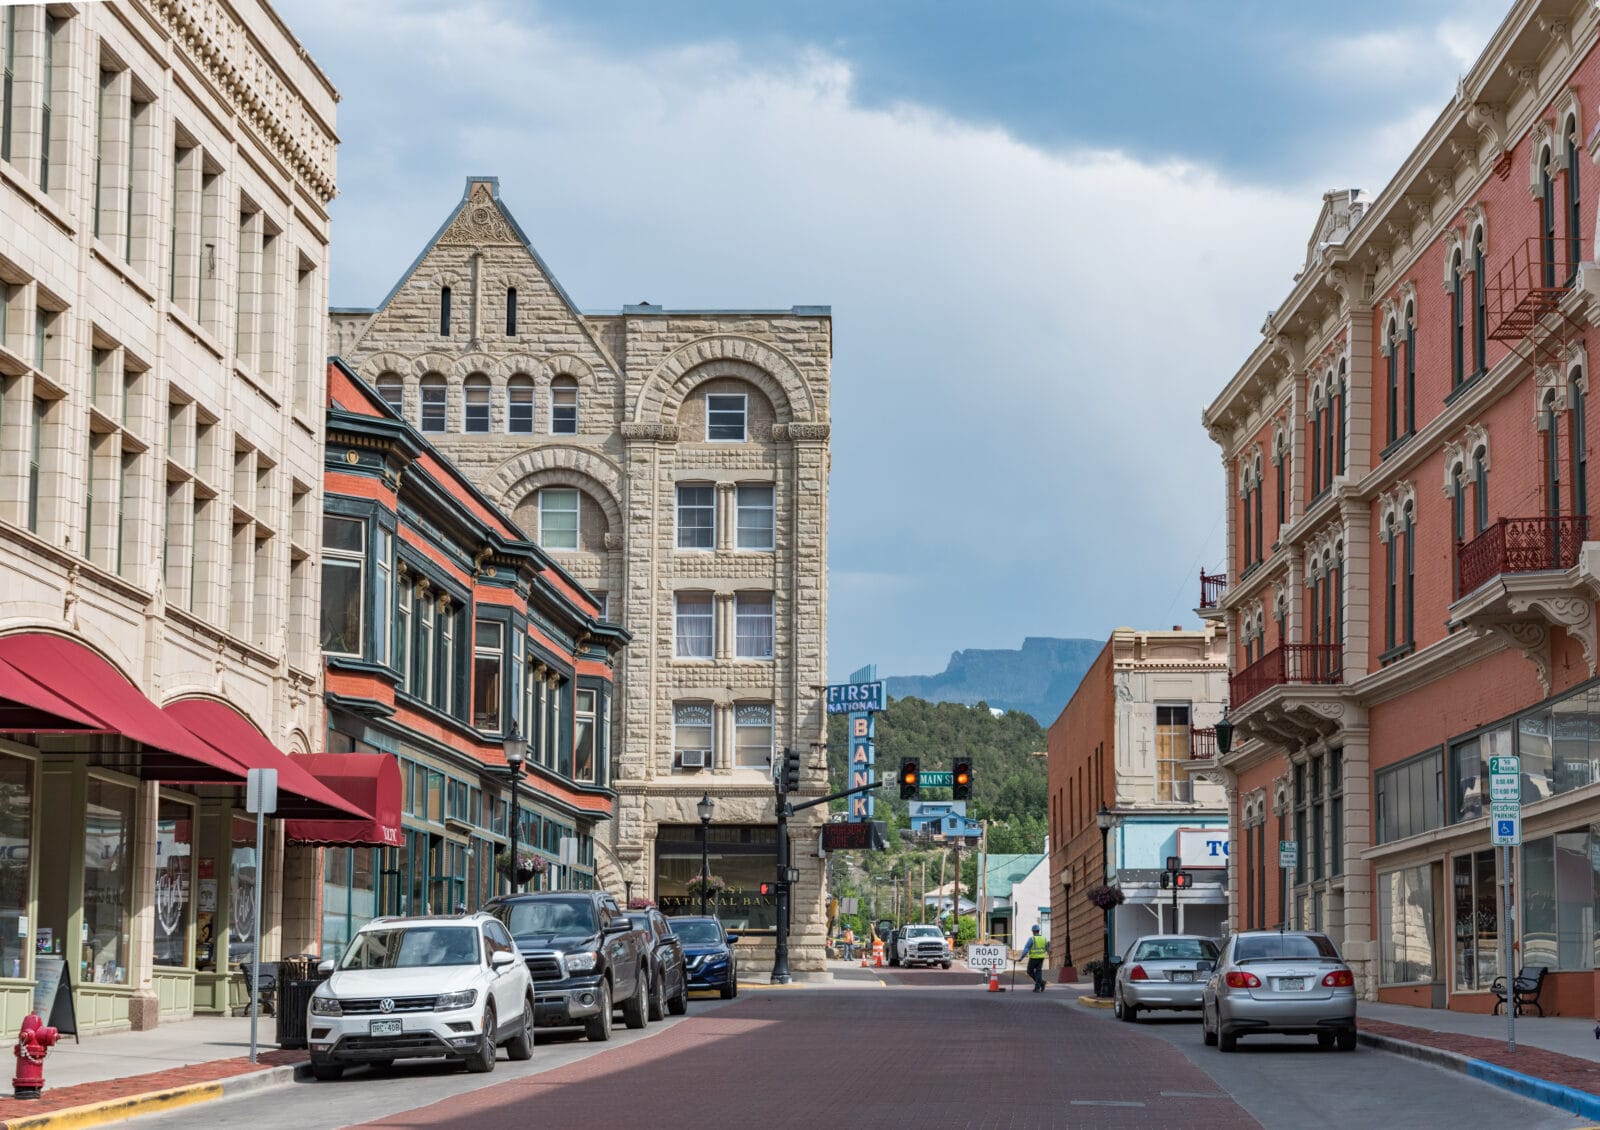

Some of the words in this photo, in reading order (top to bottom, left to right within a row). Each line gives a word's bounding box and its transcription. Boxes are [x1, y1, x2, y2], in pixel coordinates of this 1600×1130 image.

[829, 683, 881, 702] FIRST
[827, 701, 880, 714] NATIONAL
[853, 718, 868, 817] BANK
[1492, 759, 1498, 771] 2
[920, 774, 943, 785] MAIN
[743, 897, 778, 905] BAN
[975, 948, 999, 956] ROAD
[970, 957, 1004, 966] CLOSED
